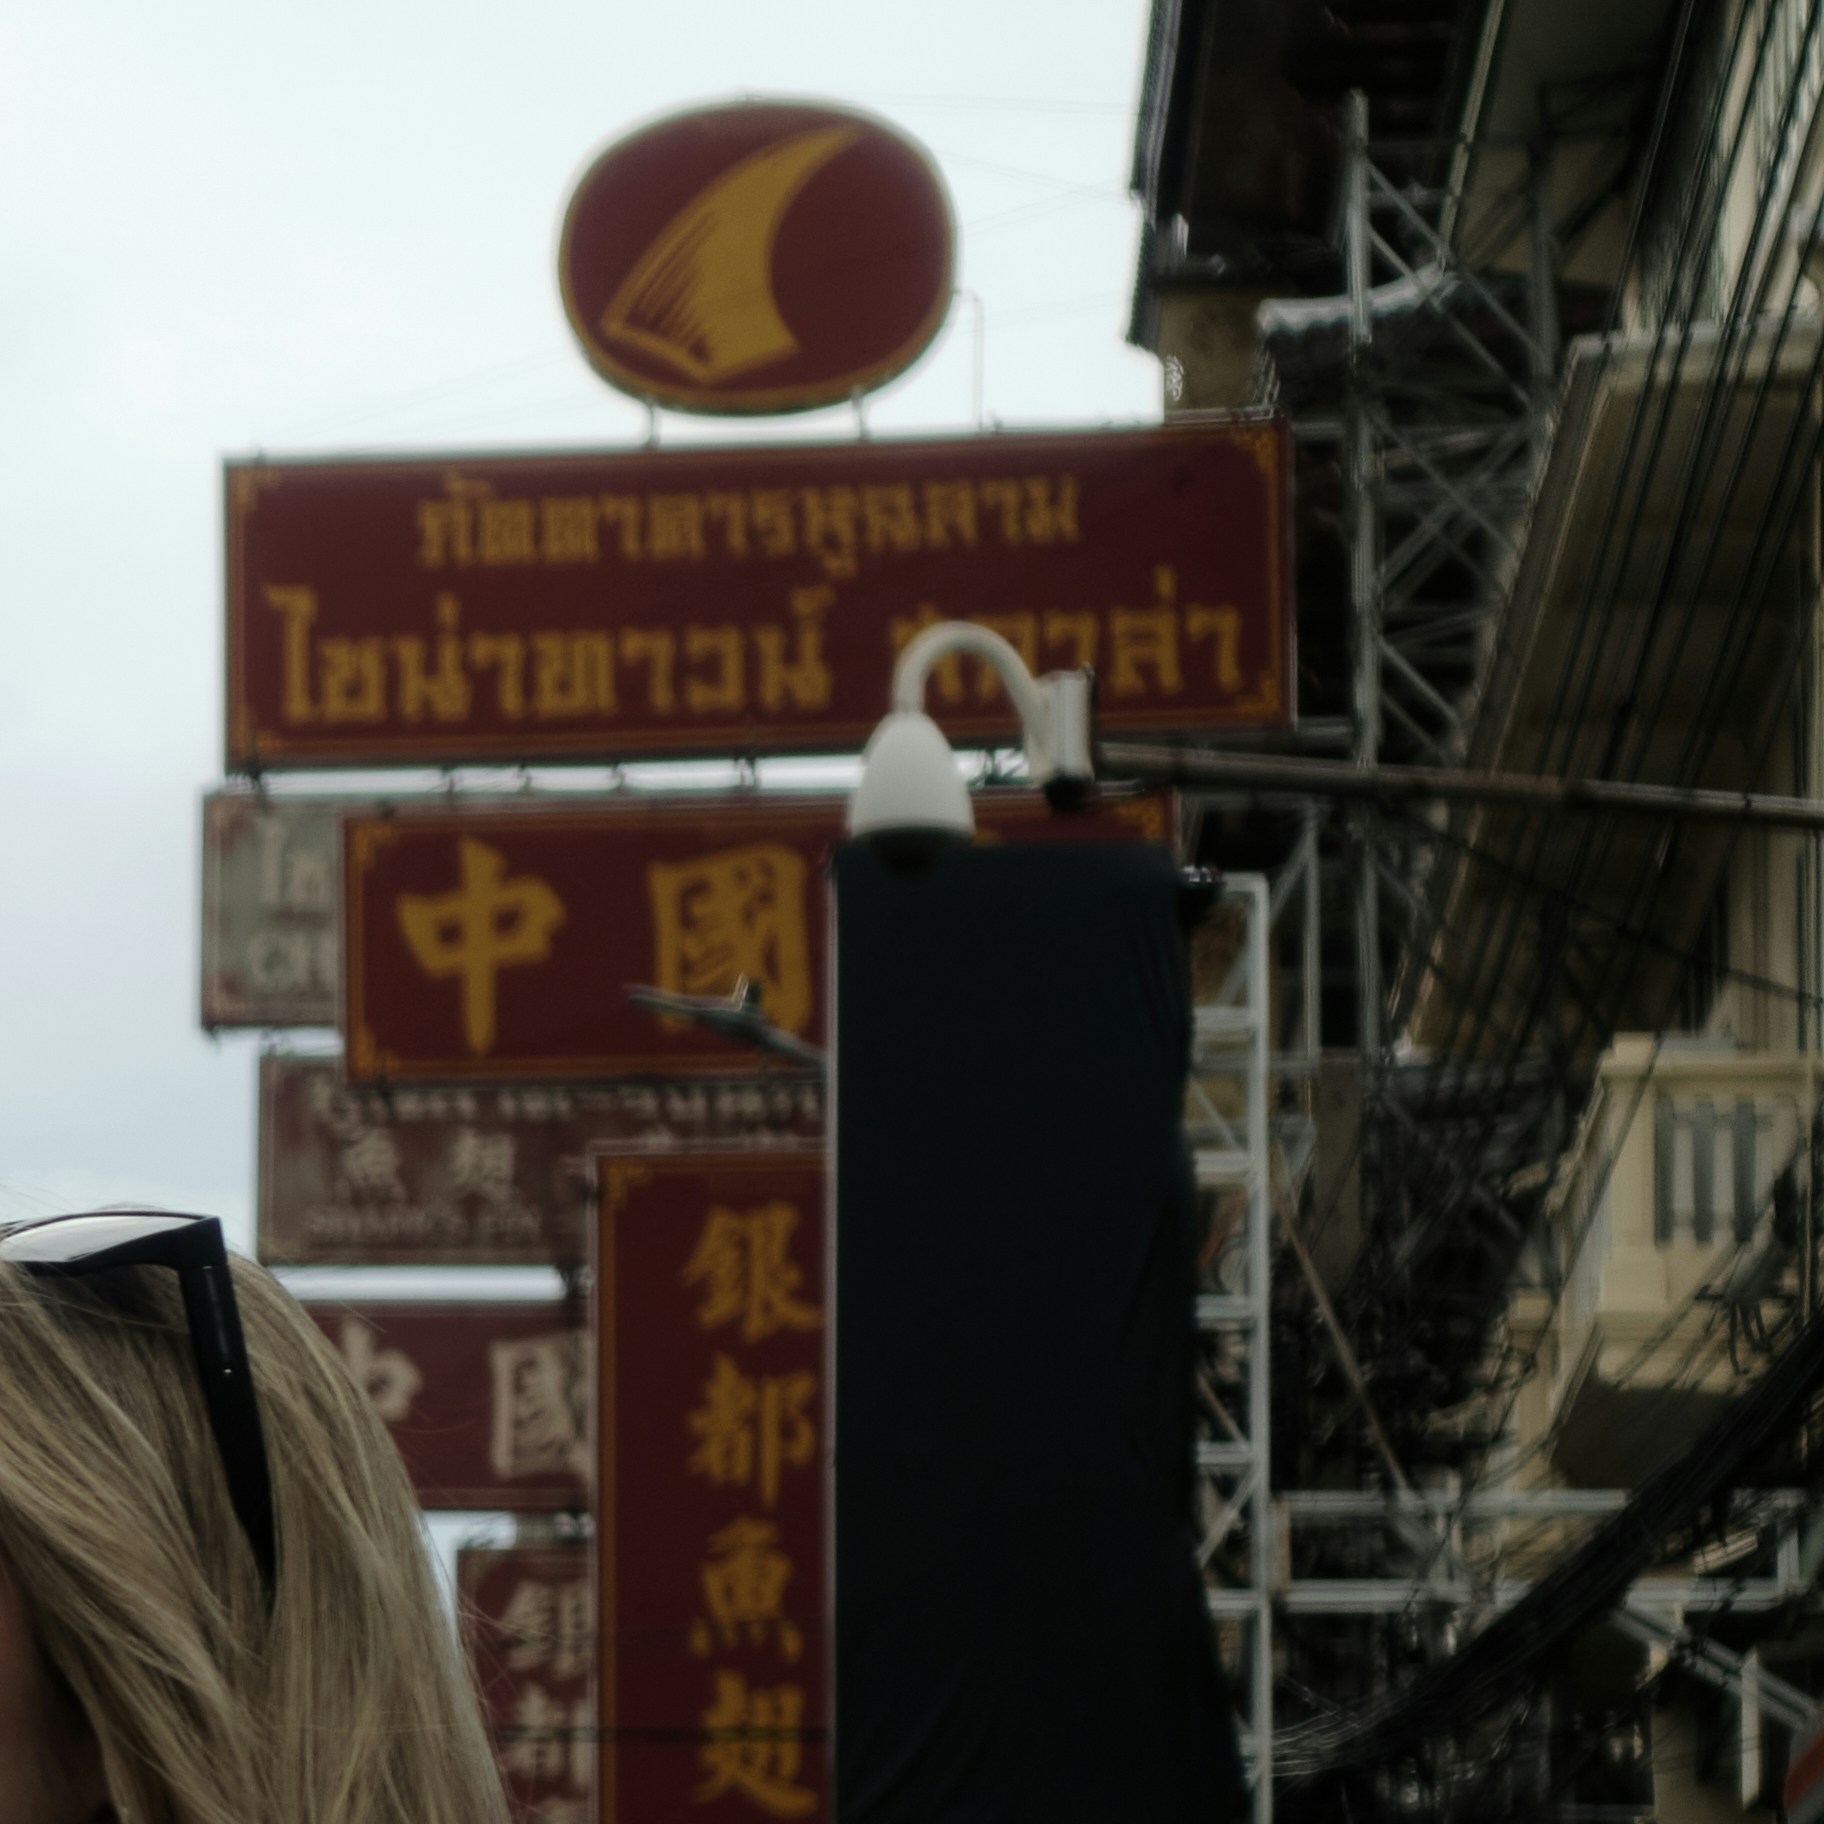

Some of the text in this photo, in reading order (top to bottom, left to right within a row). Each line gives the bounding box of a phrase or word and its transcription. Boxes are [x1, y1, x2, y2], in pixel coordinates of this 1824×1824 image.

[418, 467, 1080, 579] ภัตตาคารหูฉลาม
[262, 582, 837, 727] ไชน่าทาวน์
